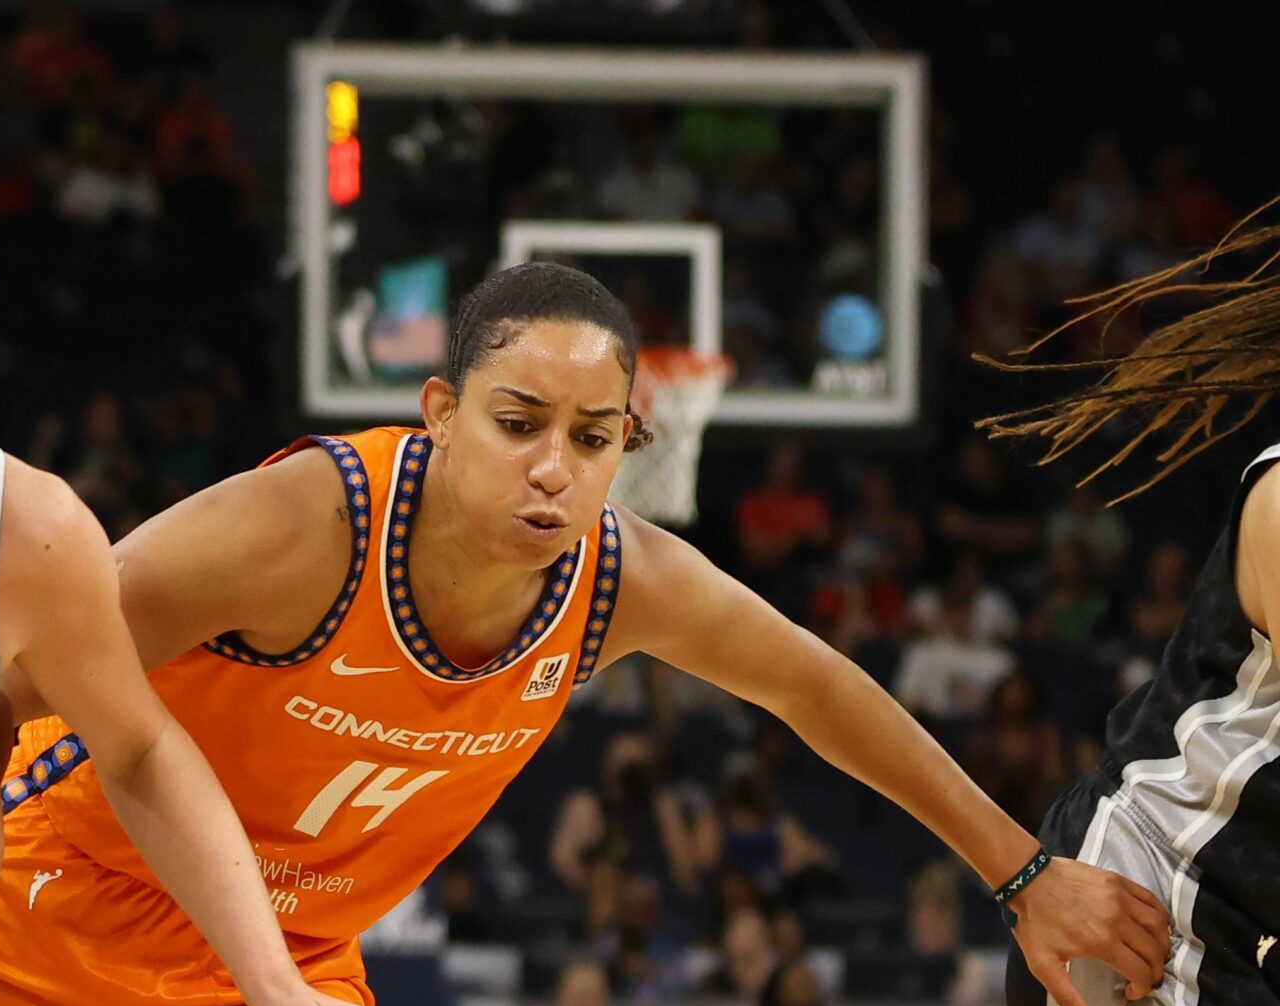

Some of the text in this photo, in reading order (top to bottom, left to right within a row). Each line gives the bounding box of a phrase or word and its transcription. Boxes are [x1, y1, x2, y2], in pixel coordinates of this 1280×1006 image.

[526, 677, 559, 693] Post
[284, 695, 541, 757] CONNECTICUT
[293, 760, 450, 838] 14
